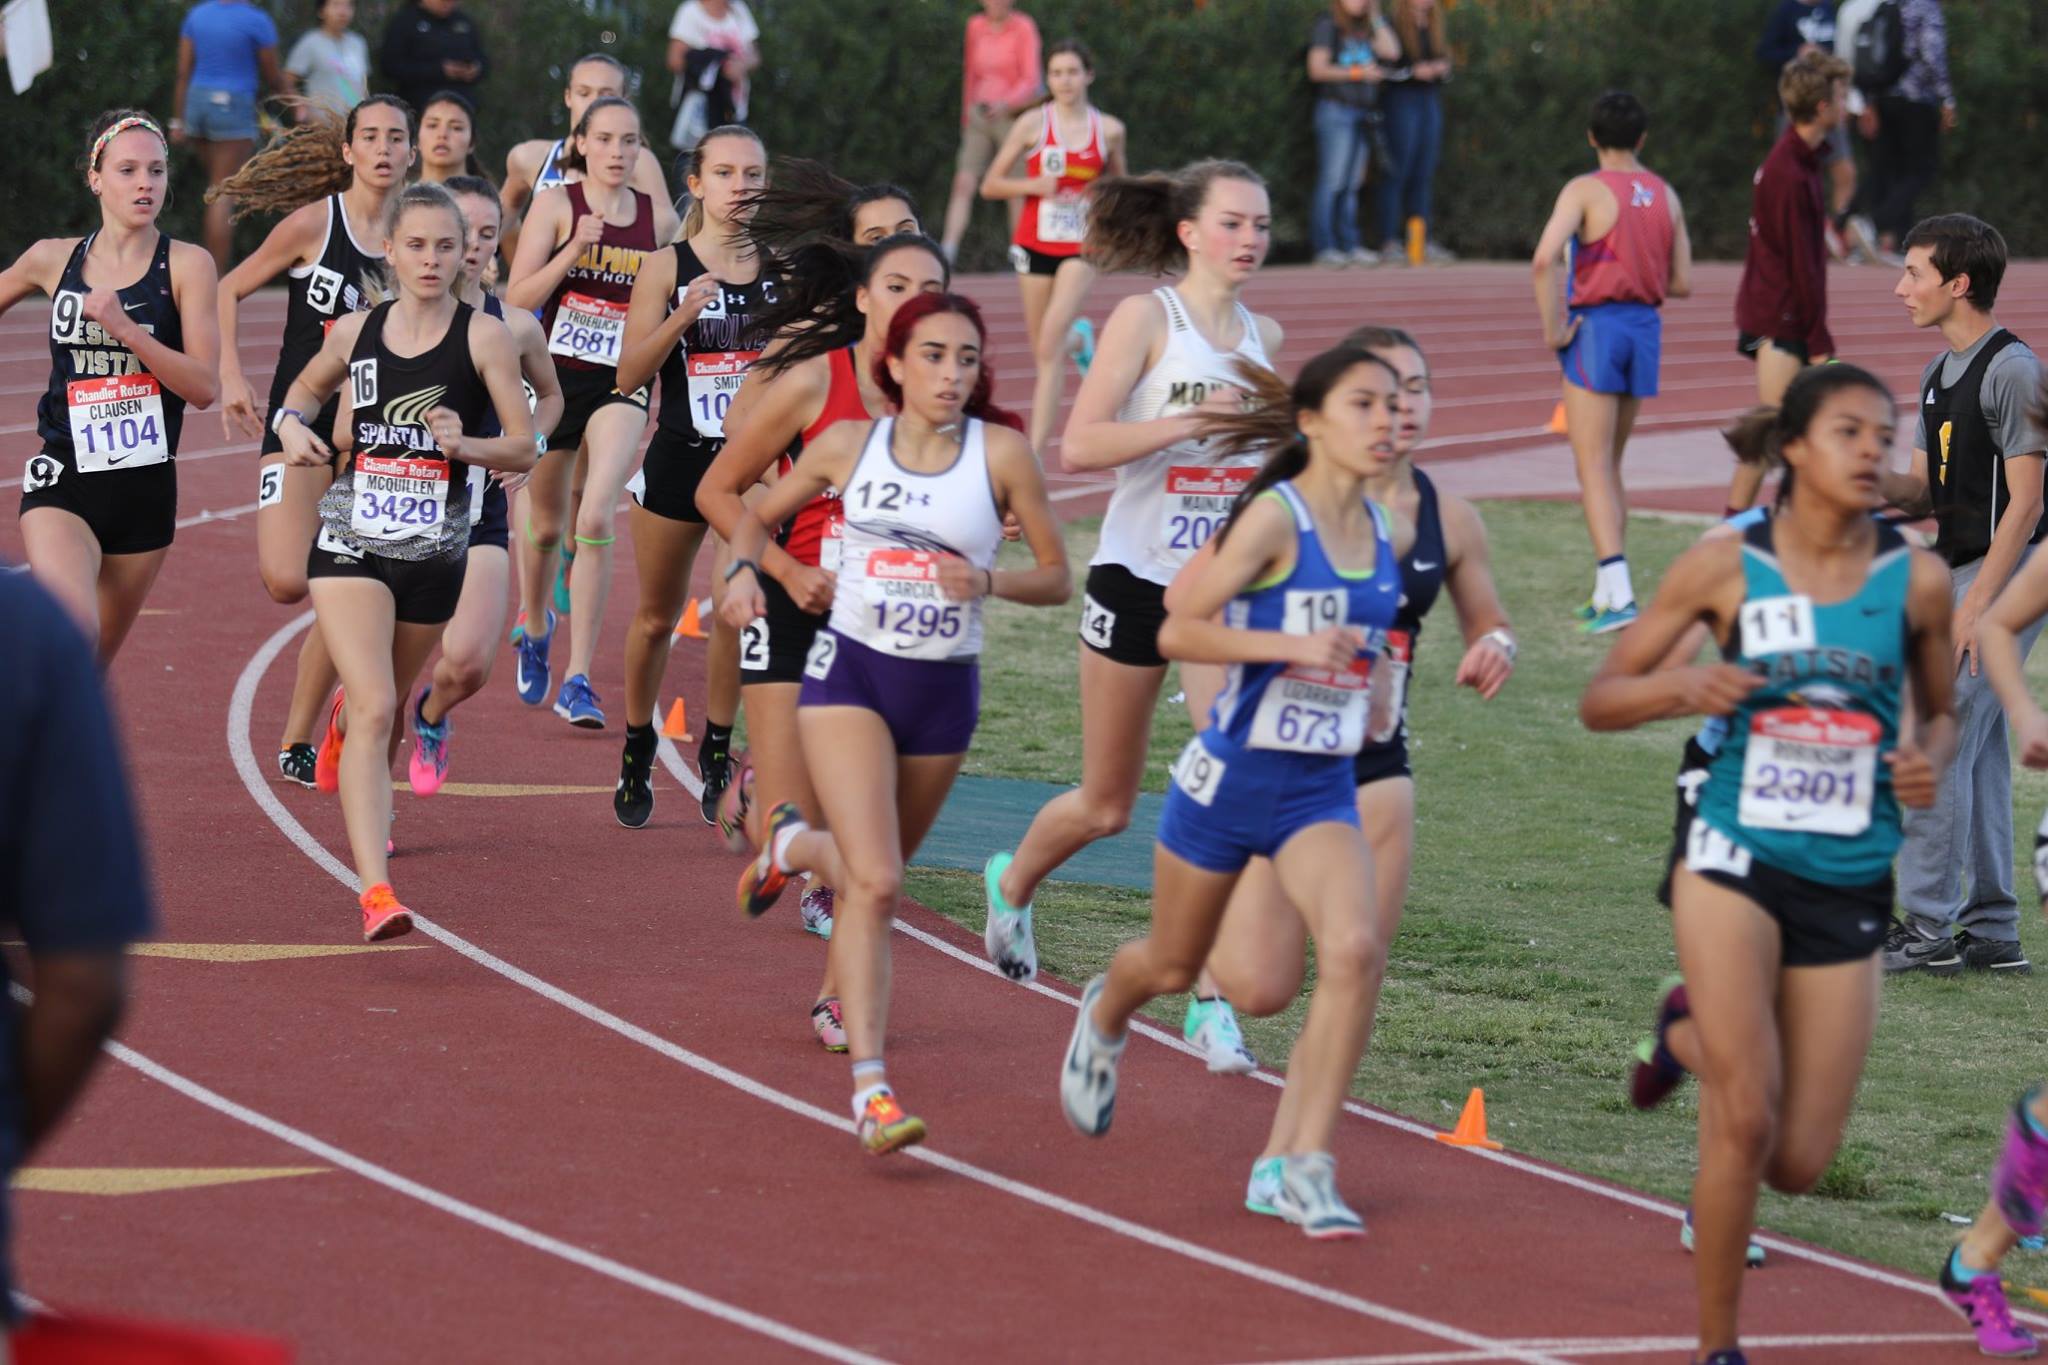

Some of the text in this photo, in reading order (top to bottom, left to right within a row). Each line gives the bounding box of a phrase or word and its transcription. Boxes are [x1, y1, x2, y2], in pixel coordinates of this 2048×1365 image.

[1047, 151, 1061, 172] 6
[310, 275, 334, 306] 5
[55, 294, 78, 338] 9
[567, 311, 620, 332] FROEHLICH
[556, 321, 616, 356] 2681
[70, 350, 142, 376] VISTA
[75, 384, 152, 404] Chandler Rotary
[352, 363, 374, 404] 16
[89, 399, 143, 420] CLAUSEN
[80, 415, 159, 453] 1104
[30, 458, 54, 485] 9
[363, 458, 442, 480] Chandler Rotary
[261, 471, 277, 500] 5
[366, 475, 435, 495] MCQUILLEN
[857, 480, 902, 511] 12
[360, 492, 438, 525] 3429
[871, 600, 961, 639] 1295
[1300, 594, 1338, 634] 19
[1751, 603, 1799, 640] 11
[1277, 703, 1341, 750] 673
[1755, 763, 1857, 806] 2301
